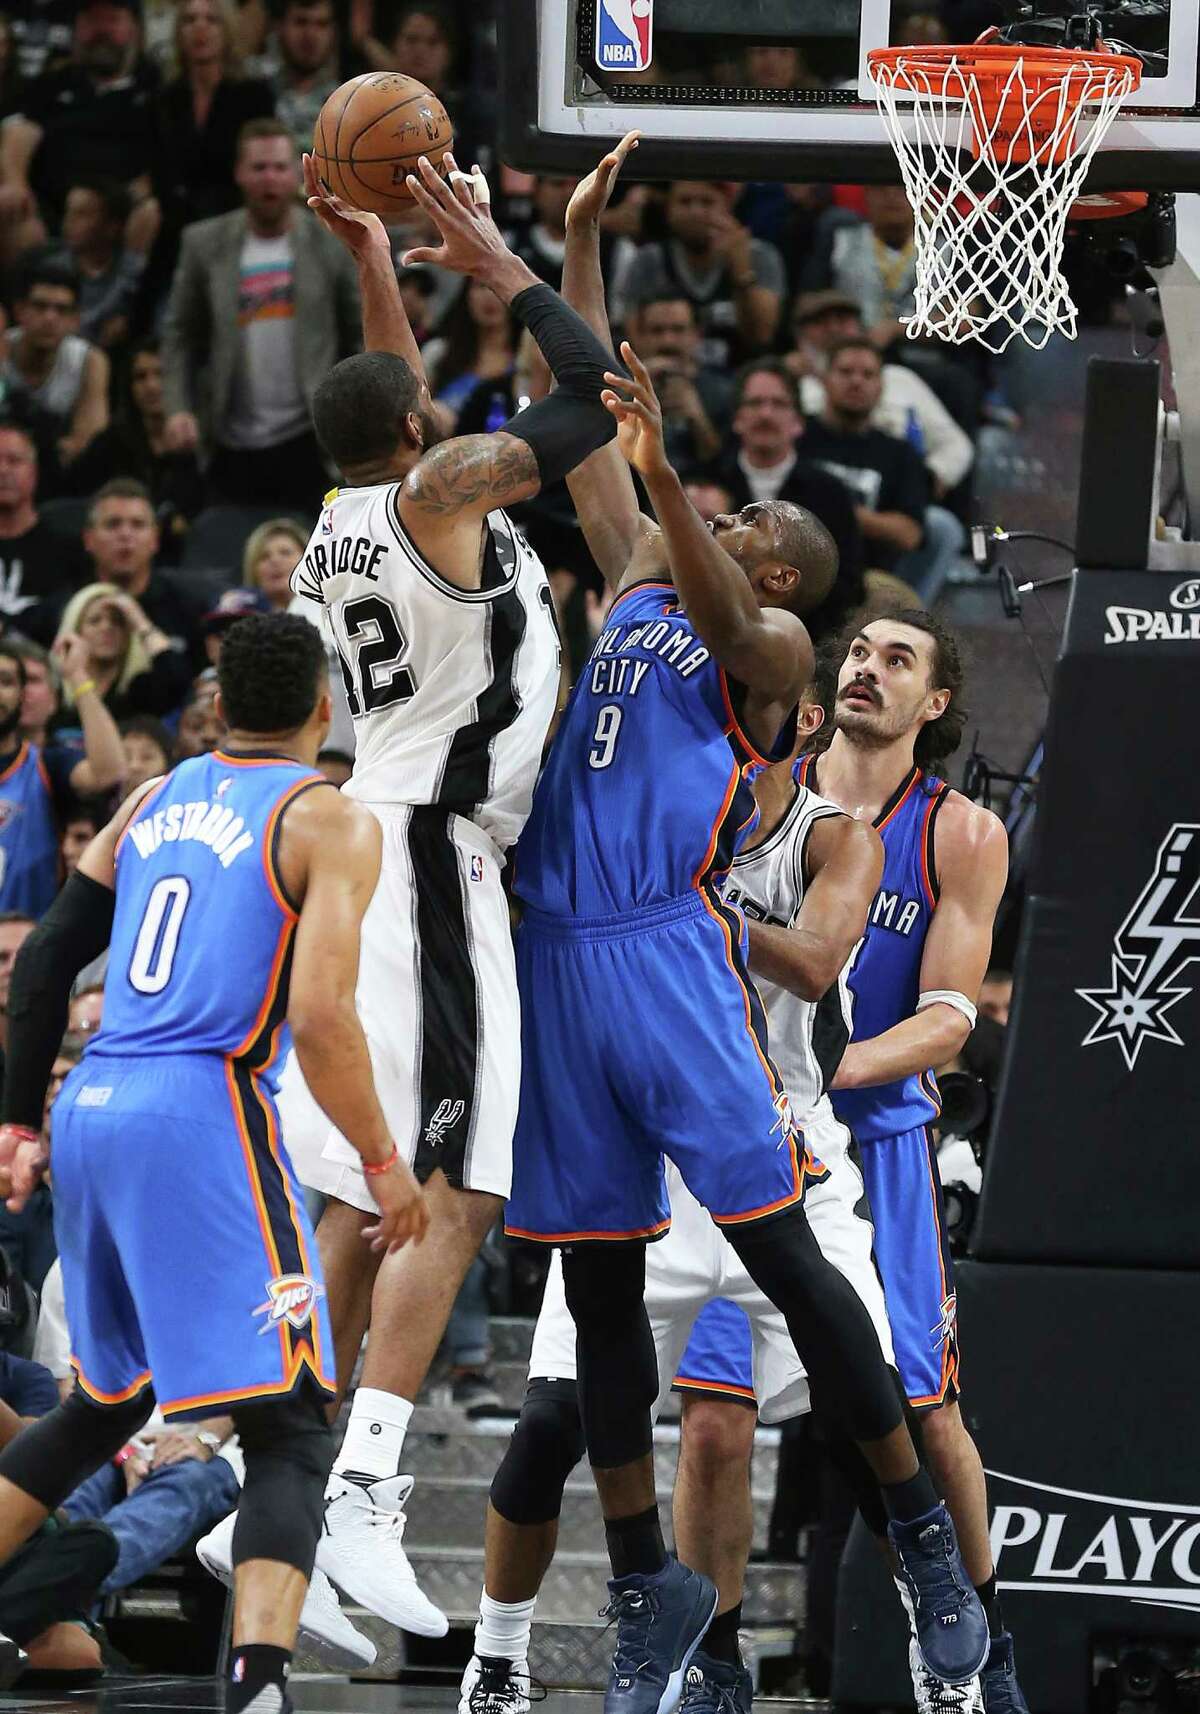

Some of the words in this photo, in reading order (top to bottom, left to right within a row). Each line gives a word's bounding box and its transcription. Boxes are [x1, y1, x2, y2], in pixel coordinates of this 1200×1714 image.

[603, 44, 635, 62] NBA
[330, 594, 418, 719] 12
[589, 621, 711, 678] KLAHOMA
[591, 658, 649, 695] CITY
[588, 704, 622, 769] 9
[129, 874, 192, 995] 0
[941, 1614, 958, 1625] 773
[618, 1679, 630, 1687] 773
